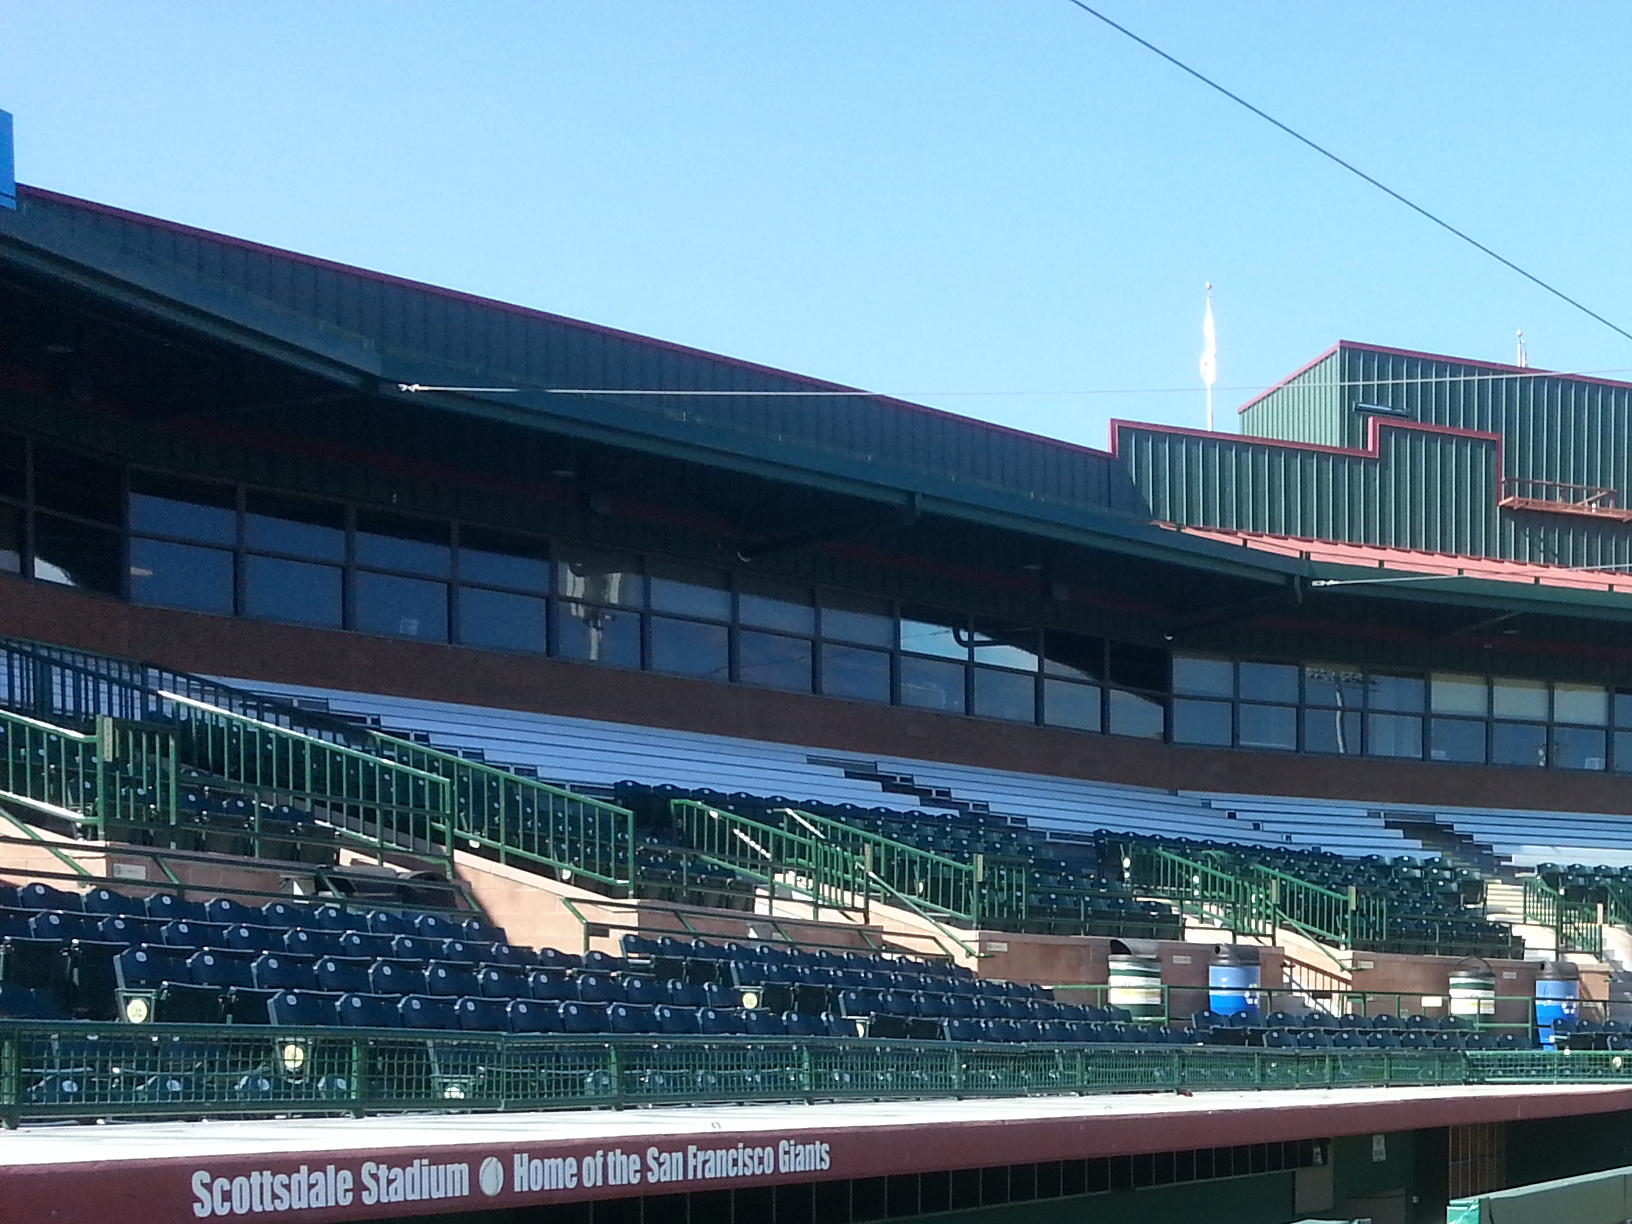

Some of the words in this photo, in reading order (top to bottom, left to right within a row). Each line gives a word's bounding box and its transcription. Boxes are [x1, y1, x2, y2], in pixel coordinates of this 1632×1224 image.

[191, 1164, 354, 1218] Scottsdale
[361, 1158, 470, 1205] Stadium
[513, 1152, 578, 1192] Home
[582, 1149, 604, 1188] of
[607, 1148, 641, 1186] the
[646, 1146, 685, 1184] San
[687, 1142, 775, 1180] Francisco
[778, 1139, 831, 1173] Giants
